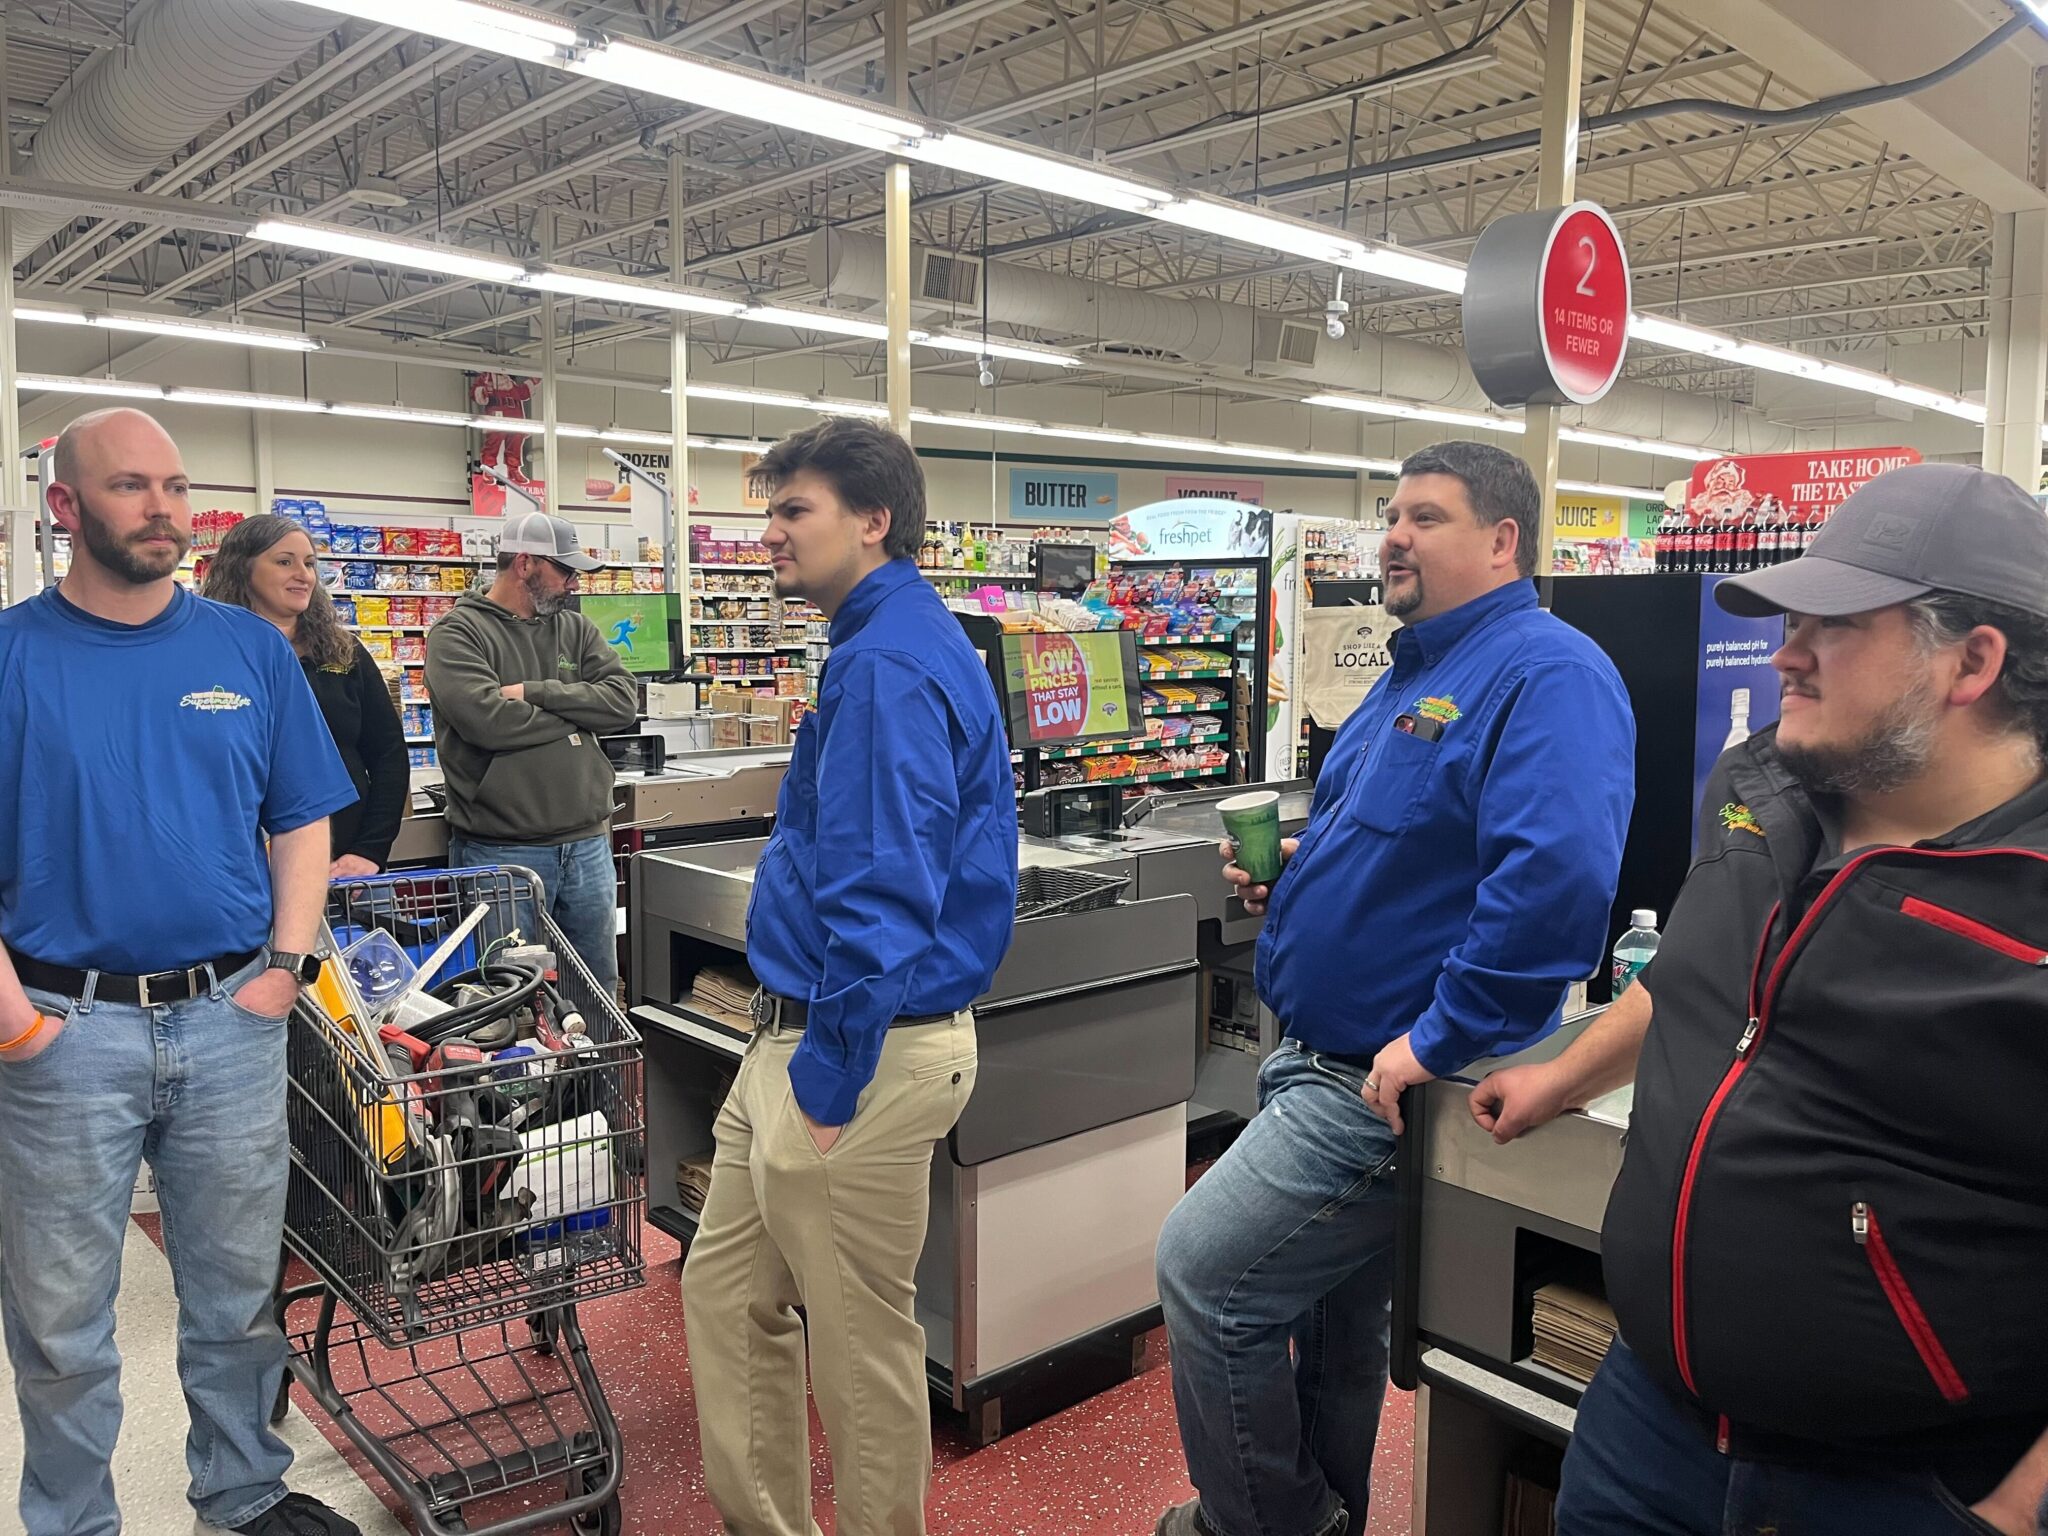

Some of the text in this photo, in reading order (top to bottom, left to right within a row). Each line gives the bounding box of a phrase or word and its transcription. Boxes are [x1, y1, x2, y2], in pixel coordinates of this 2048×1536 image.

[1576, 235, 1597, 297] 2
[1554, 307, 1614, 336] 14 ITEMS OR
[1566, 334, 1600, 356] FEWER
[618, 453, 670, 469] OZEN
[1808, 460, 1853, 480] TAKE
[1025, 481, 1087, 508] BUTTER
[1791, 483, 1824, 502] THE
[1556, 506, 1597, 527] JUICE
[1159, 527, 1213, 548] freshpet
[1343, 643, 1362, 651] SHOP
[1706, 639, 1768, 655] purely balanced pH for
[1026, 647, 1074, 676] LOW
[1334, 651, 1389, 668] LOCAL
[1705, 655, 1725, 670] purely
[1725, 654, 1750, 667] balanced
[1030, 671, 1078, 691] PRICES
[1032, 686, 1080, 703] THAT STAY
[1034, 697, 1082, 728] LOW
